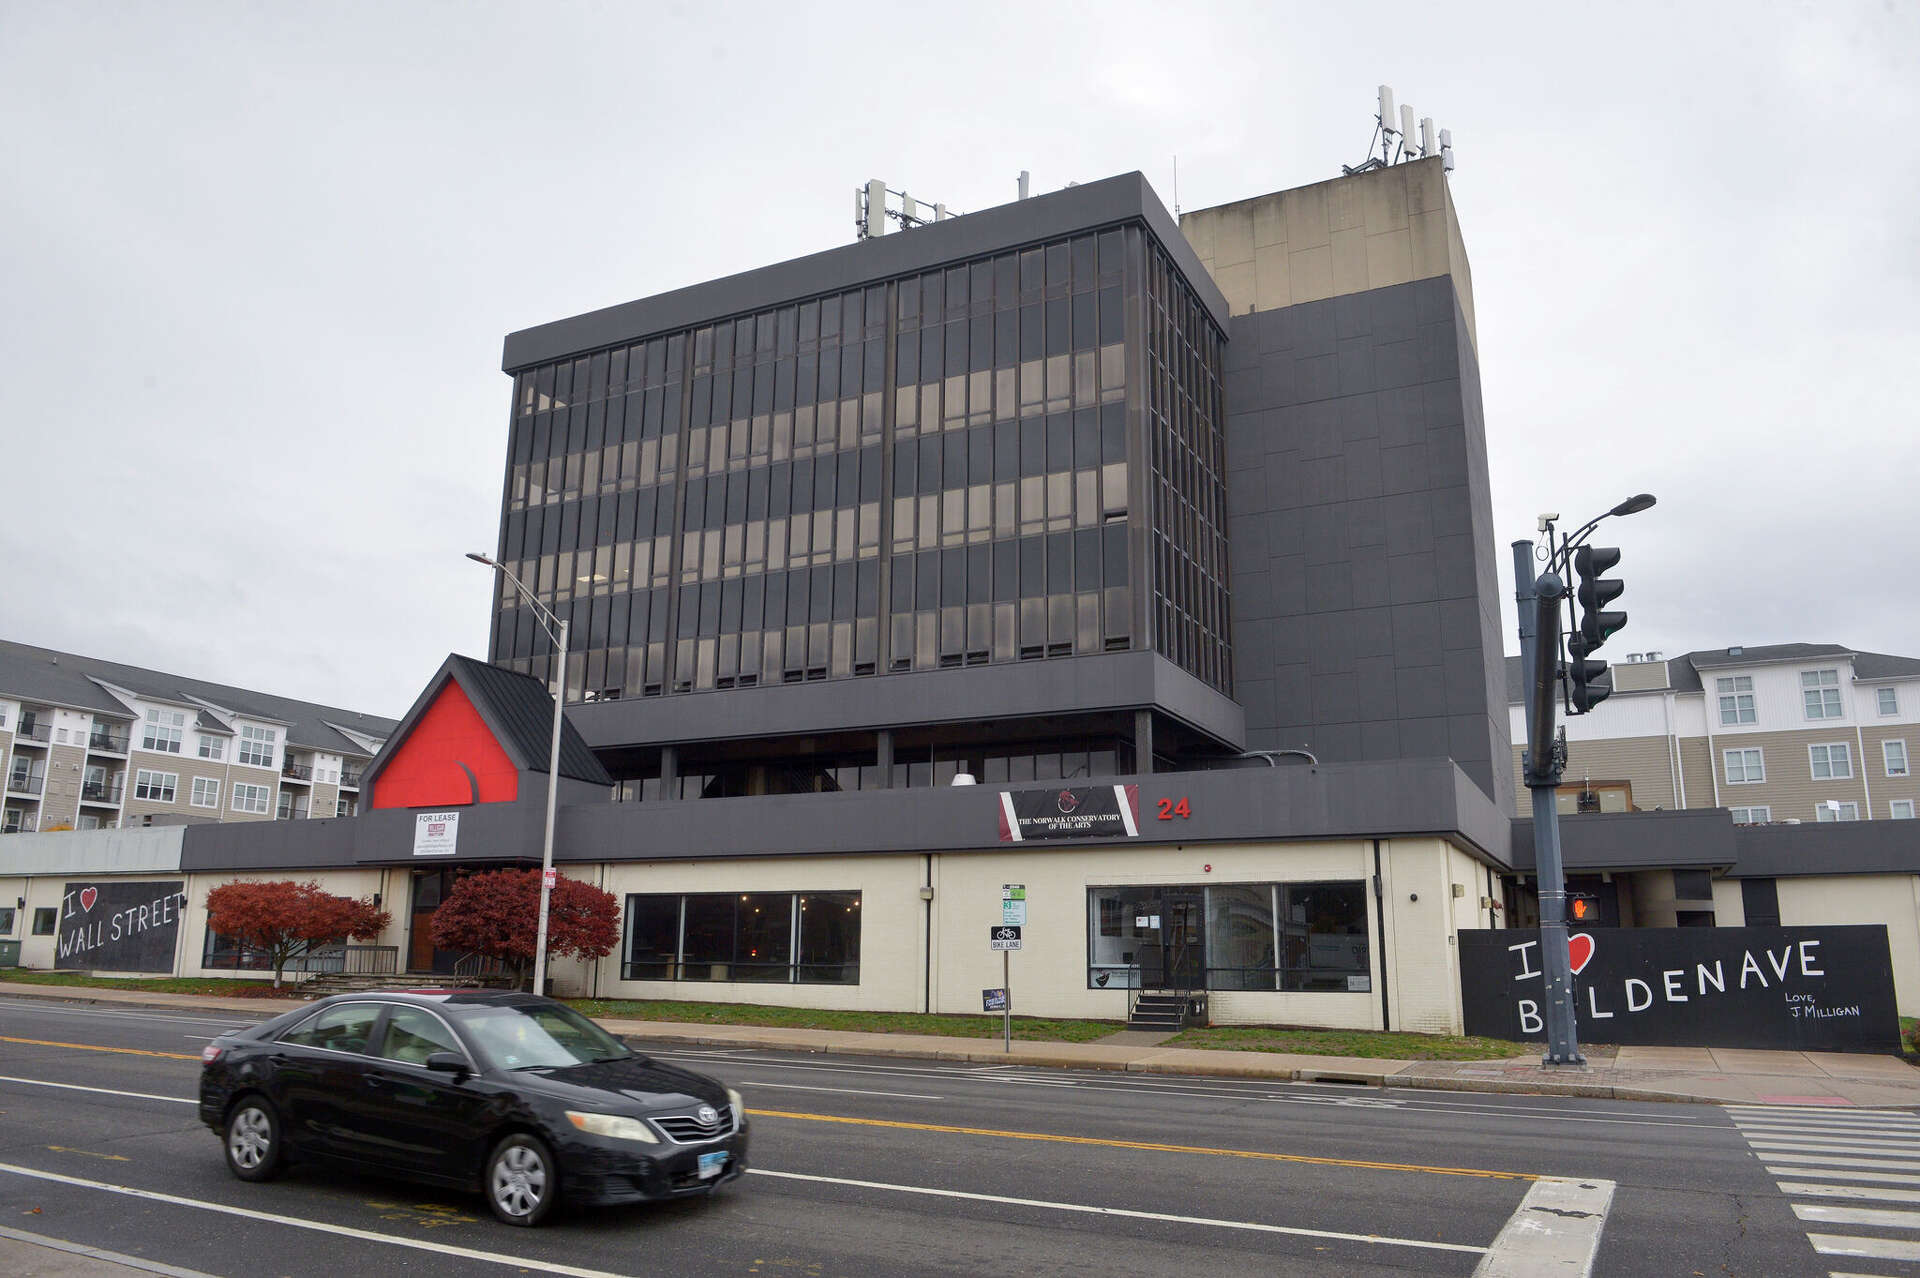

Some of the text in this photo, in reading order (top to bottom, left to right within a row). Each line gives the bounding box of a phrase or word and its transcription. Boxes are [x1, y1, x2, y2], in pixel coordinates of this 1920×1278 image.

[419, 814, 456, 823] FOR LEASE
[1033, 816, 1066, 824] NORWALK
[1066, 813, 1120, 823] CONSERVATORY
[1157, 797, 1192, 820] 24
[1059, 822, 1072, 830] THE
[1072, 821, 1091, 829] ARTS
[63, 890, 77, 919] I
[59, 891, 184, 959] WALL STREET
[992, 940, 1020, 948] BIKE LANE
[1508, 940, 1542, 981] I
[1518, 959, 1726, 1034] BLDEN
